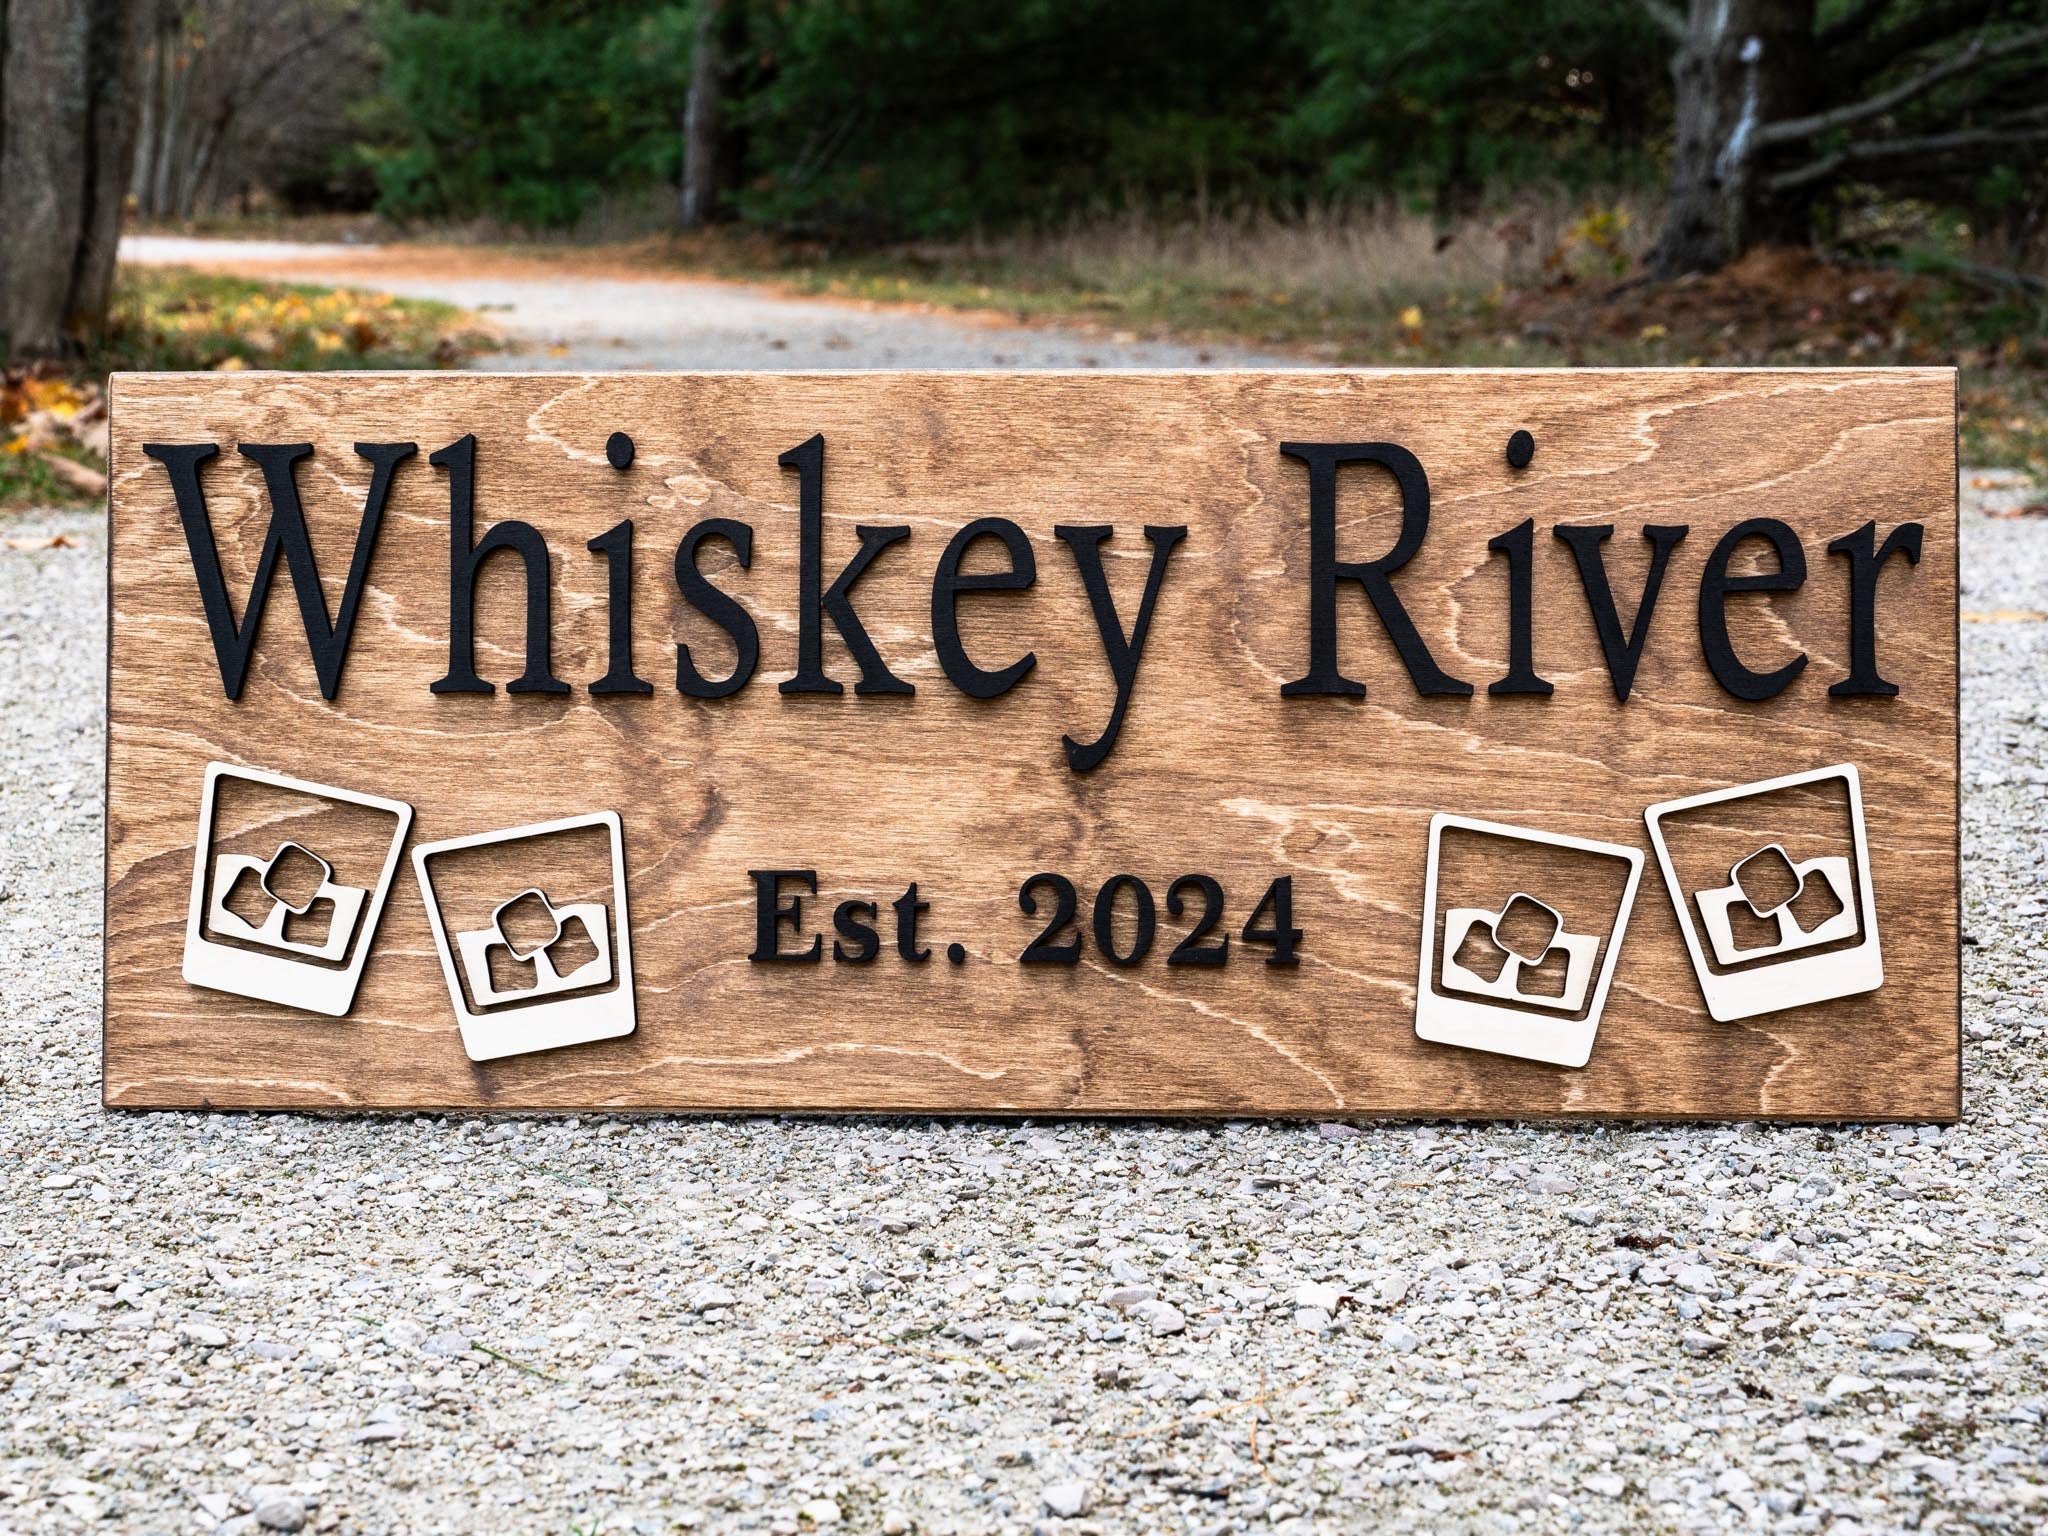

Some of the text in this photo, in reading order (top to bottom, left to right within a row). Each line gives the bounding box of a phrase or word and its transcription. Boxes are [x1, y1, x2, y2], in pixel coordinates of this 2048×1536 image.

[143, 430, 1924, 772] Whiskey River
[748, 869, 1304, 969] Est. 2024
